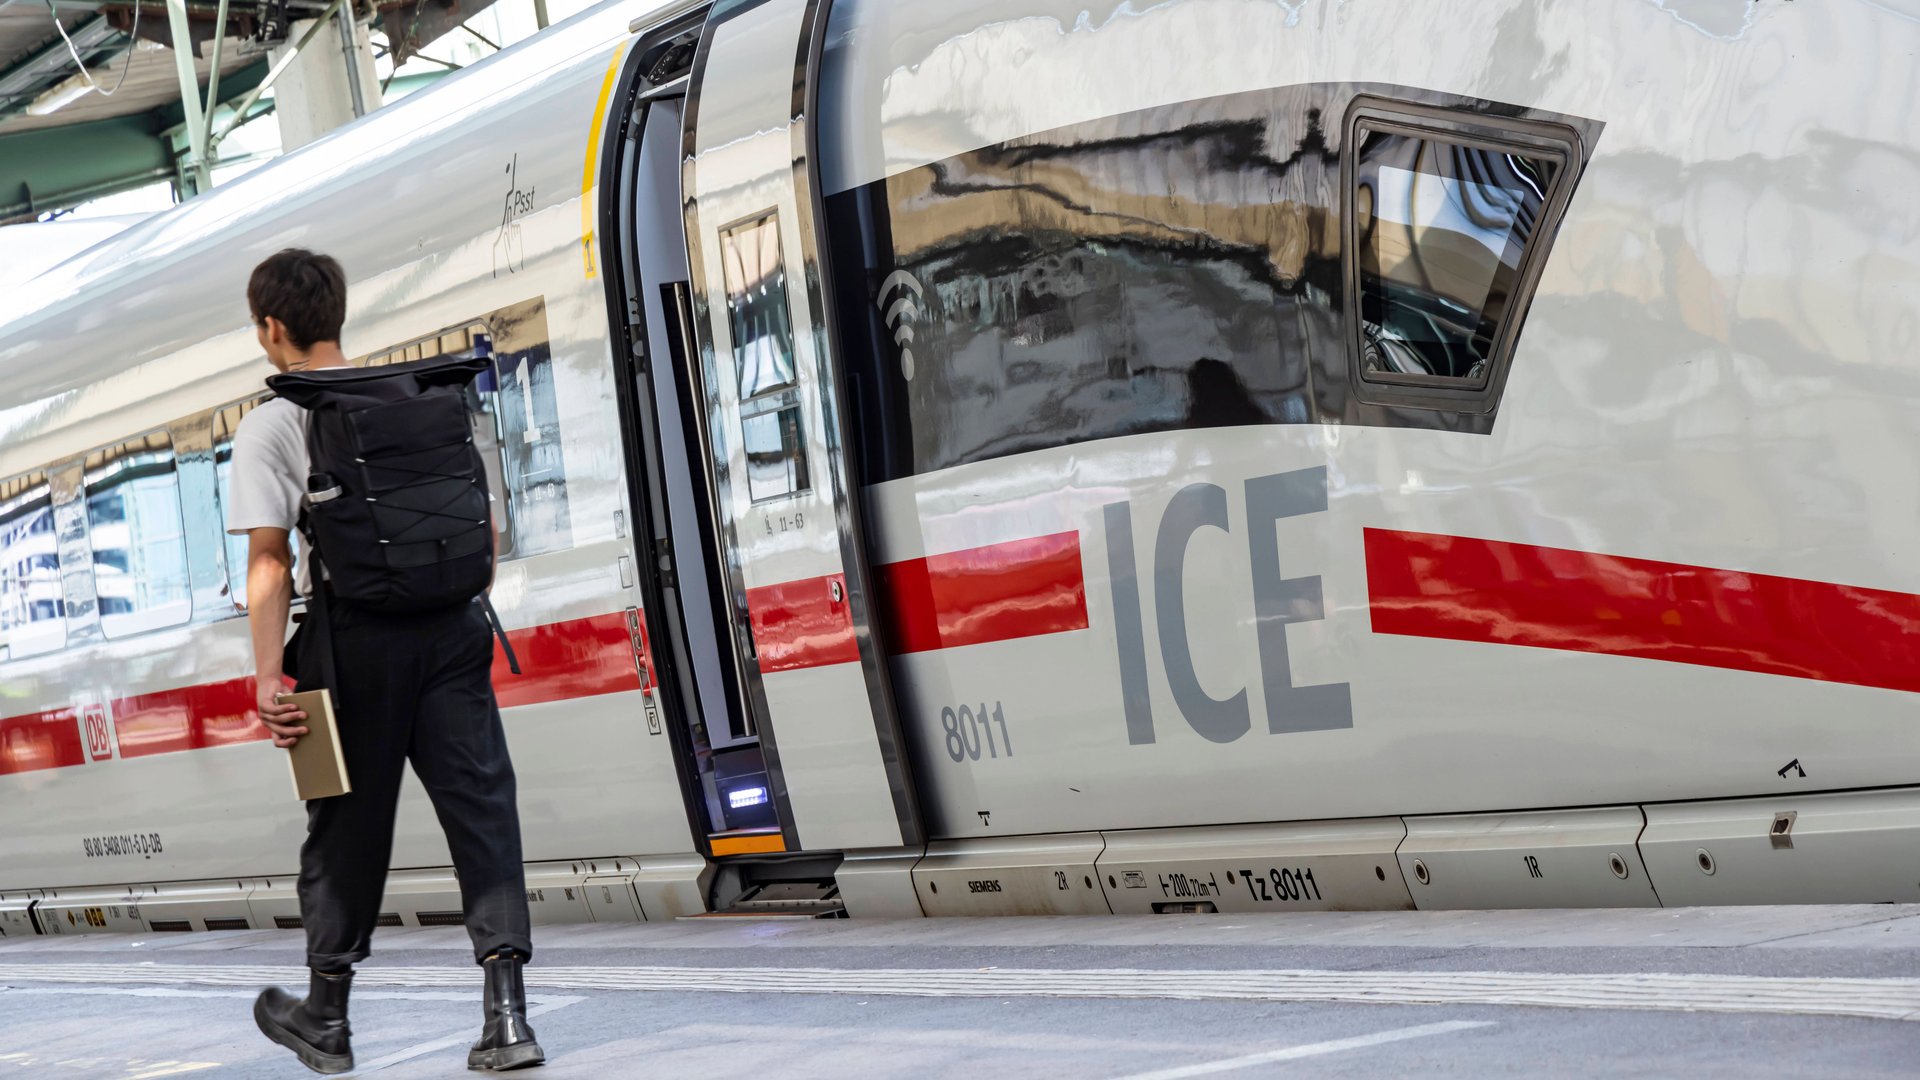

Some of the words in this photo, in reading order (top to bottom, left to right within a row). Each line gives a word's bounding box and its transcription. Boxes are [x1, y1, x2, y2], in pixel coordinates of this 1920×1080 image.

[513, 185, 535, 216] Psst
[516, 356, 541, 443] 1
[1103, 465, 1354, 745] ICE
[87, 713, 107, 752] DB
[941, 701, 1013, 763] 8011
[1055, 871, 1070, 891] 2R
[1239, 869, 1273, 901] Tz
[1269, 867, 1322, 901] 8011
[1524, 855, 1544, 879] 1R
[968, 879, 1002, 893] SIEMENS
